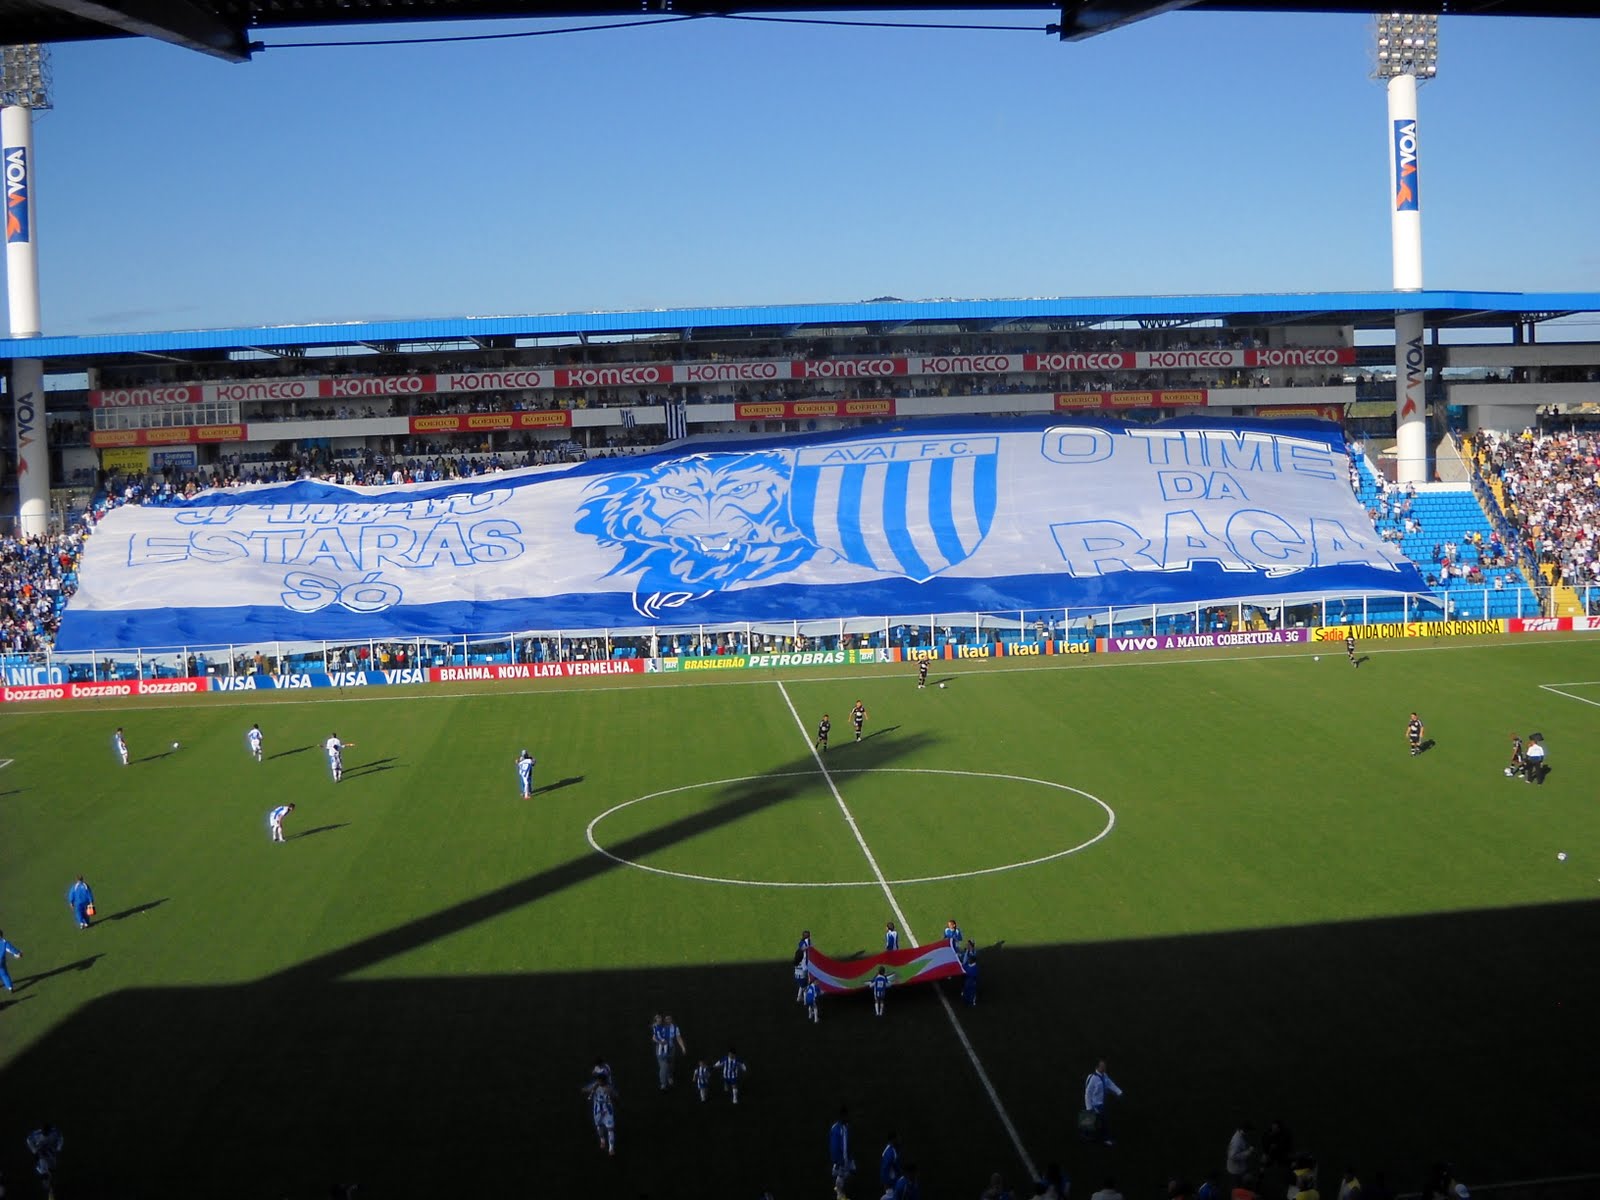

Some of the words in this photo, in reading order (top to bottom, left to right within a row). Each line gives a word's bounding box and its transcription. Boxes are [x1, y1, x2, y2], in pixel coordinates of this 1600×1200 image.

[922, 356, 1009, 373] KOMECO
[1036, 353, 1123, 370] KOMECO
[1149, 351, 1233, 367] KOMECO
[1257, 349, 1339, 365] KOMECO
[568, 367, 660, 385] KOMECO
[688, 363, 777, 380] KOMECO
[805, 359, 895, 376] KOMECO
[333, 376, 423, 395] KOMECO
[451, 372, 541, 390] KOMECO
[101, 387, 190, 406] KOMECO
[216, 381, 305, 401] KOMECO
[1041, 425, 1113, 463] O
[1125, 429, 1336, 480] TIME
[1158, 470, 1250, 501] DA
[1050, 509, 1401, 578] RAÇA
[281, 571, 403, 612] SÓ
[1315, 628, 1344, 641] Sadia
[1356, 625, 1378, 639] VIDA
[1381, 624, 1404, 638] COM
[1407, 623, 1416, 636] S
[1427, 621, 1452, 636] MAIS
[1454, 619, 1500, 635] GOSTOSA
[1521, 618, 1559, 631] TAM
[1059, 640, 1090, 654] Itaú
[1165, 637, 1174, 648] A
[1177, 635, 1214, 648] MAIOR
[1219, 631, 1282, 644] COBERTURA
[1286, 631, 1299, 642] 3G
[907, 646, 938, 661] Itaú
[958, 644, 989, 658] Itaú
[1008, 641, 1039, 656] Itaú
[684, 657, 745, 669] BRASILEIRÃO
[749, 652, 845, 667] PETROBRAS
[327, 671, 368, 686] VISA
[382, 669, 424, 683] VISA
[440, 668, 494, 681] BRAHMA.
[498, 665, 530, 678] NOVA
[534, 664, 561, 677] LATA
[567, 661, 634, 676] VERMELHA.
[139, 681, 197, 694] bozzano
[217, 675, 256, 691] VISA
[271, 673, 312, 689] VISA
[5, 687, 64, 701] bozzano
[71, 684, 131, 698] bozzano
